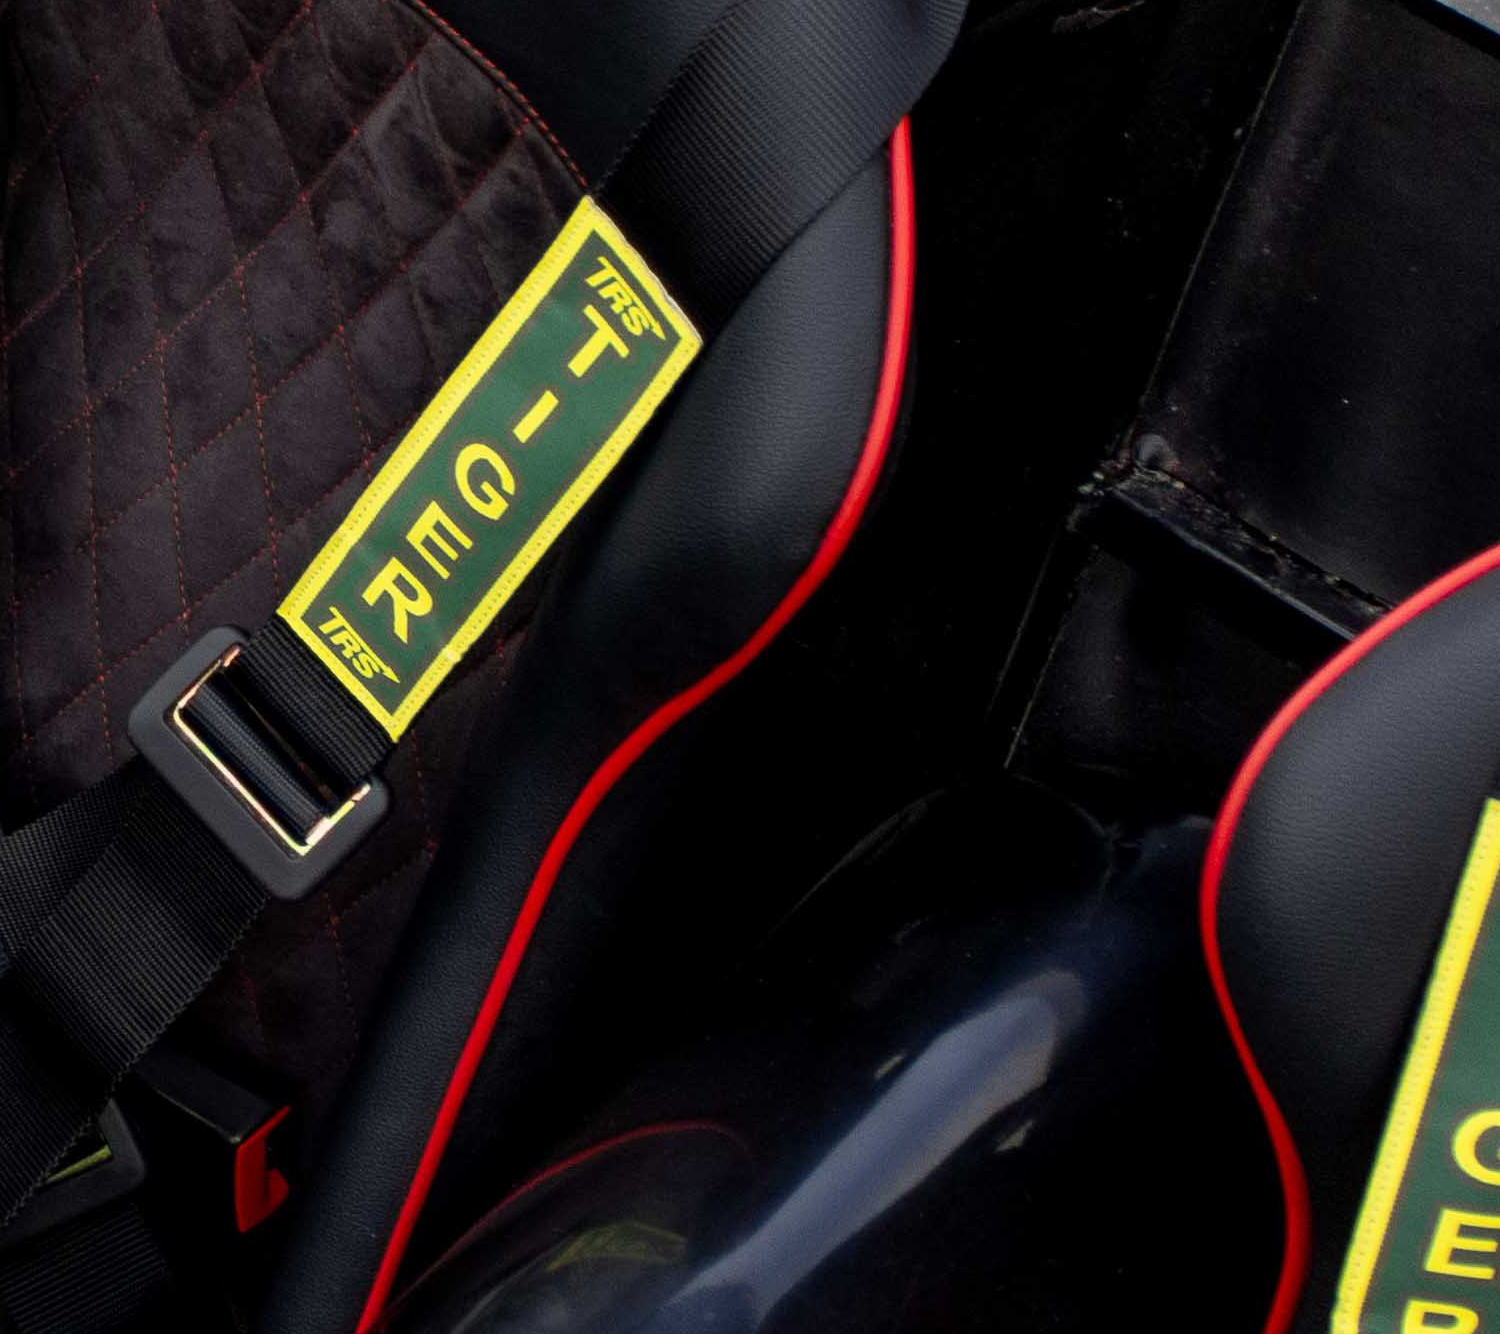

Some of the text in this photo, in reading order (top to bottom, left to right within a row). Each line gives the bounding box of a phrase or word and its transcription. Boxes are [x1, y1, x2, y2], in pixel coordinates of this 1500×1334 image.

[585, 256, 666, 341] TRS
[361, 304, 631, 644] TIGER
[318, 606, 401, 685] TRS
